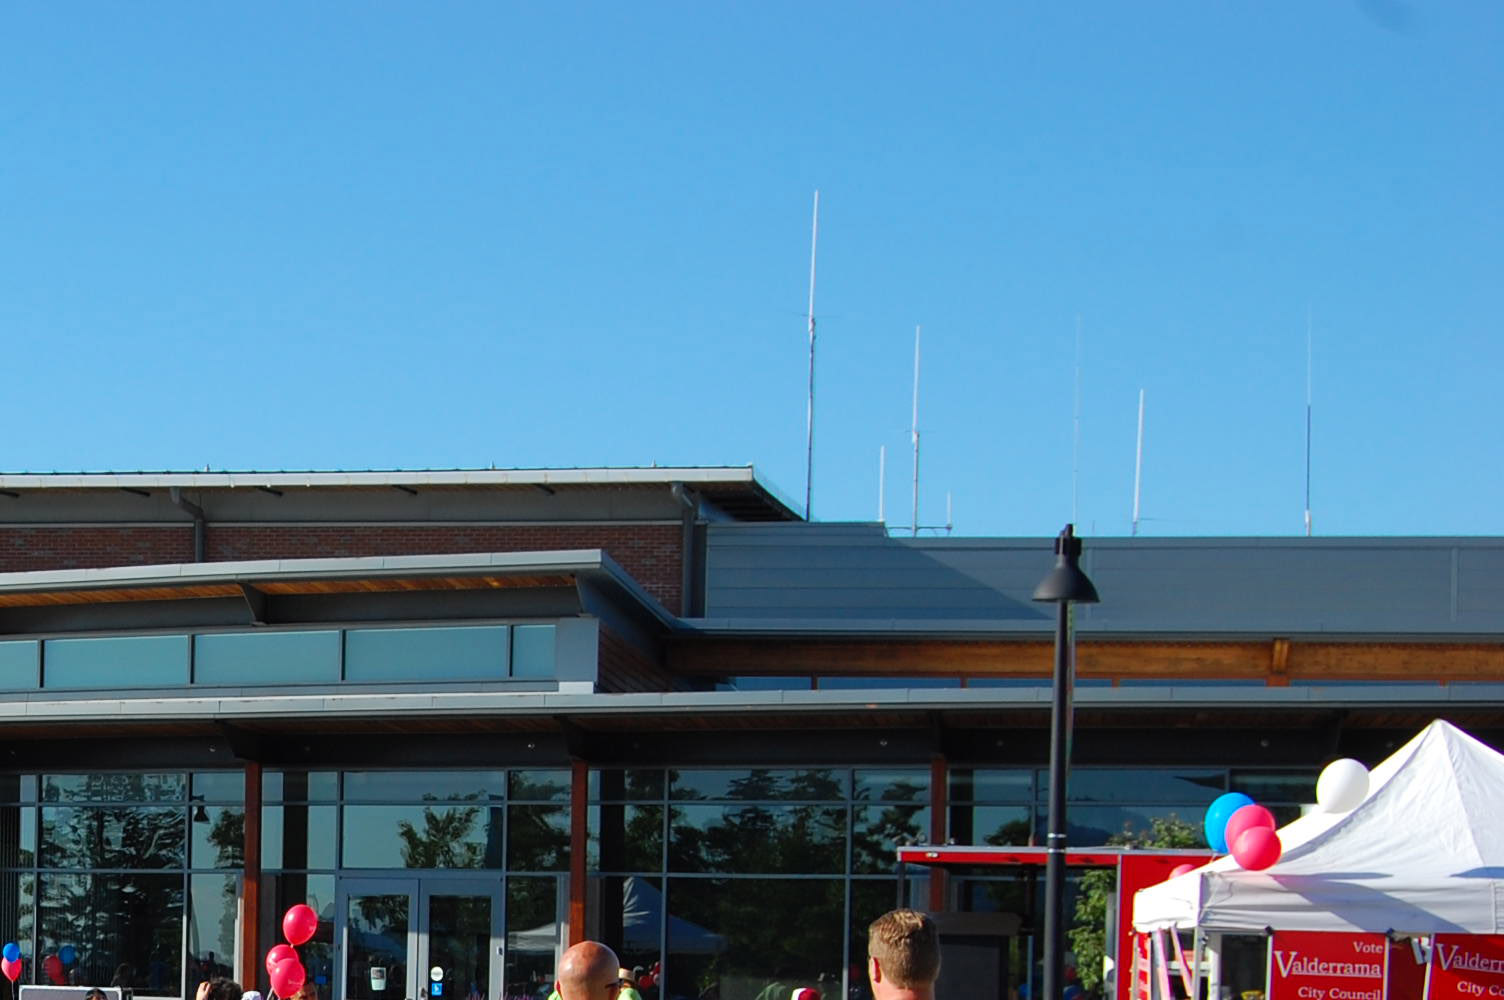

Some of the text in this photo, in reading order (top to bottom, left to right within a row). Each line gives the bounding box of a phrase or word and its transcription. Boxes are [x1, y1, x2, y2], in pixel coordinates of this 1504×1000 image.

[1353, 941, 1384, 953] Vote
[1273, 950, 1382, 978] Valderrama
[1298, 986, 1381, 1000] City Council
[1457, 980, 1485, 997] City
